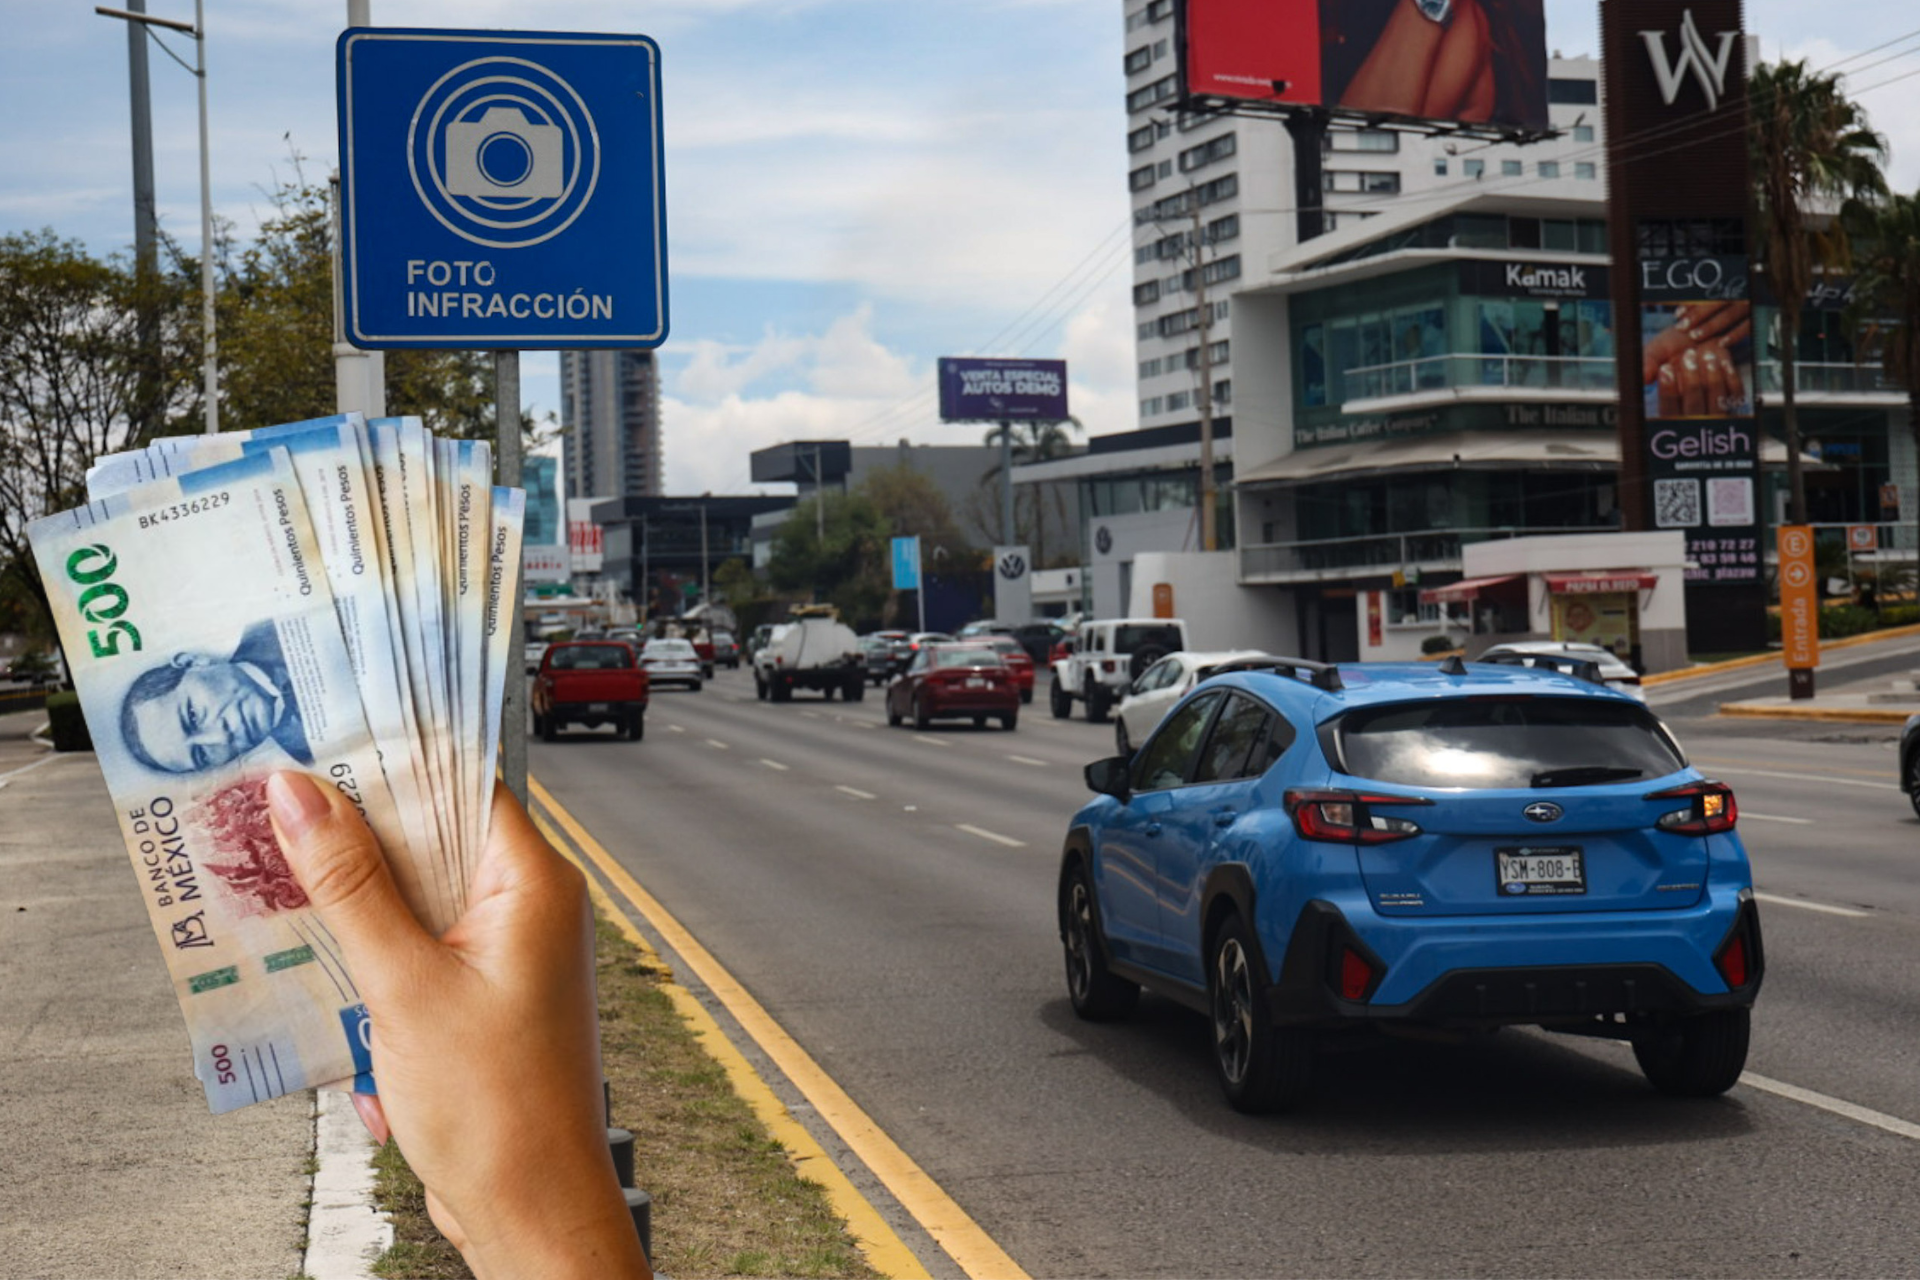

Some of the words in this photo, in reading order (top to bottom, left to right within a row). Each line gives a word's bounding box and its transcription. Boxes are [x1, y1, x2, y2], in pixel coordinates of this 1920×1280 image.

[406, 259, 496, 287] FOTO
[1641, 257, 1722, 291] EGO
[406, 287, 613, 320] INFRACCIÓN
[960, 369, 1002, 382] VENTA
[1003, 370, 1060, 384] ESPECIAL
[961, 381, 1012, 396] AUTOS
[1015, 382, 1061, 397] DEMO
[1504, 405, 1539, 425] The
[1543, 405, 1598, 425] Italian
[1650, 425, 1750, 459] Gelish
[337, 465, 352, 503] Pesos
[138, 491, 230, 530] BK4336229
[273, 488, 292, 526] Pesos
[345, 503, 364, 575] Quinientos
[491, 526, 507, 563] Pesos
[283, 526, 312, 596] Quinientos
[65, 543, 142, 659] 500
[1791, 597, 1809, 663] Entrada
[129, 807, 151, 835] DE
[149, 796, 202, 903] MÉXICO
[139, 841, 174, 907] BANCO
[210, 1043, 236, 1085] 500
